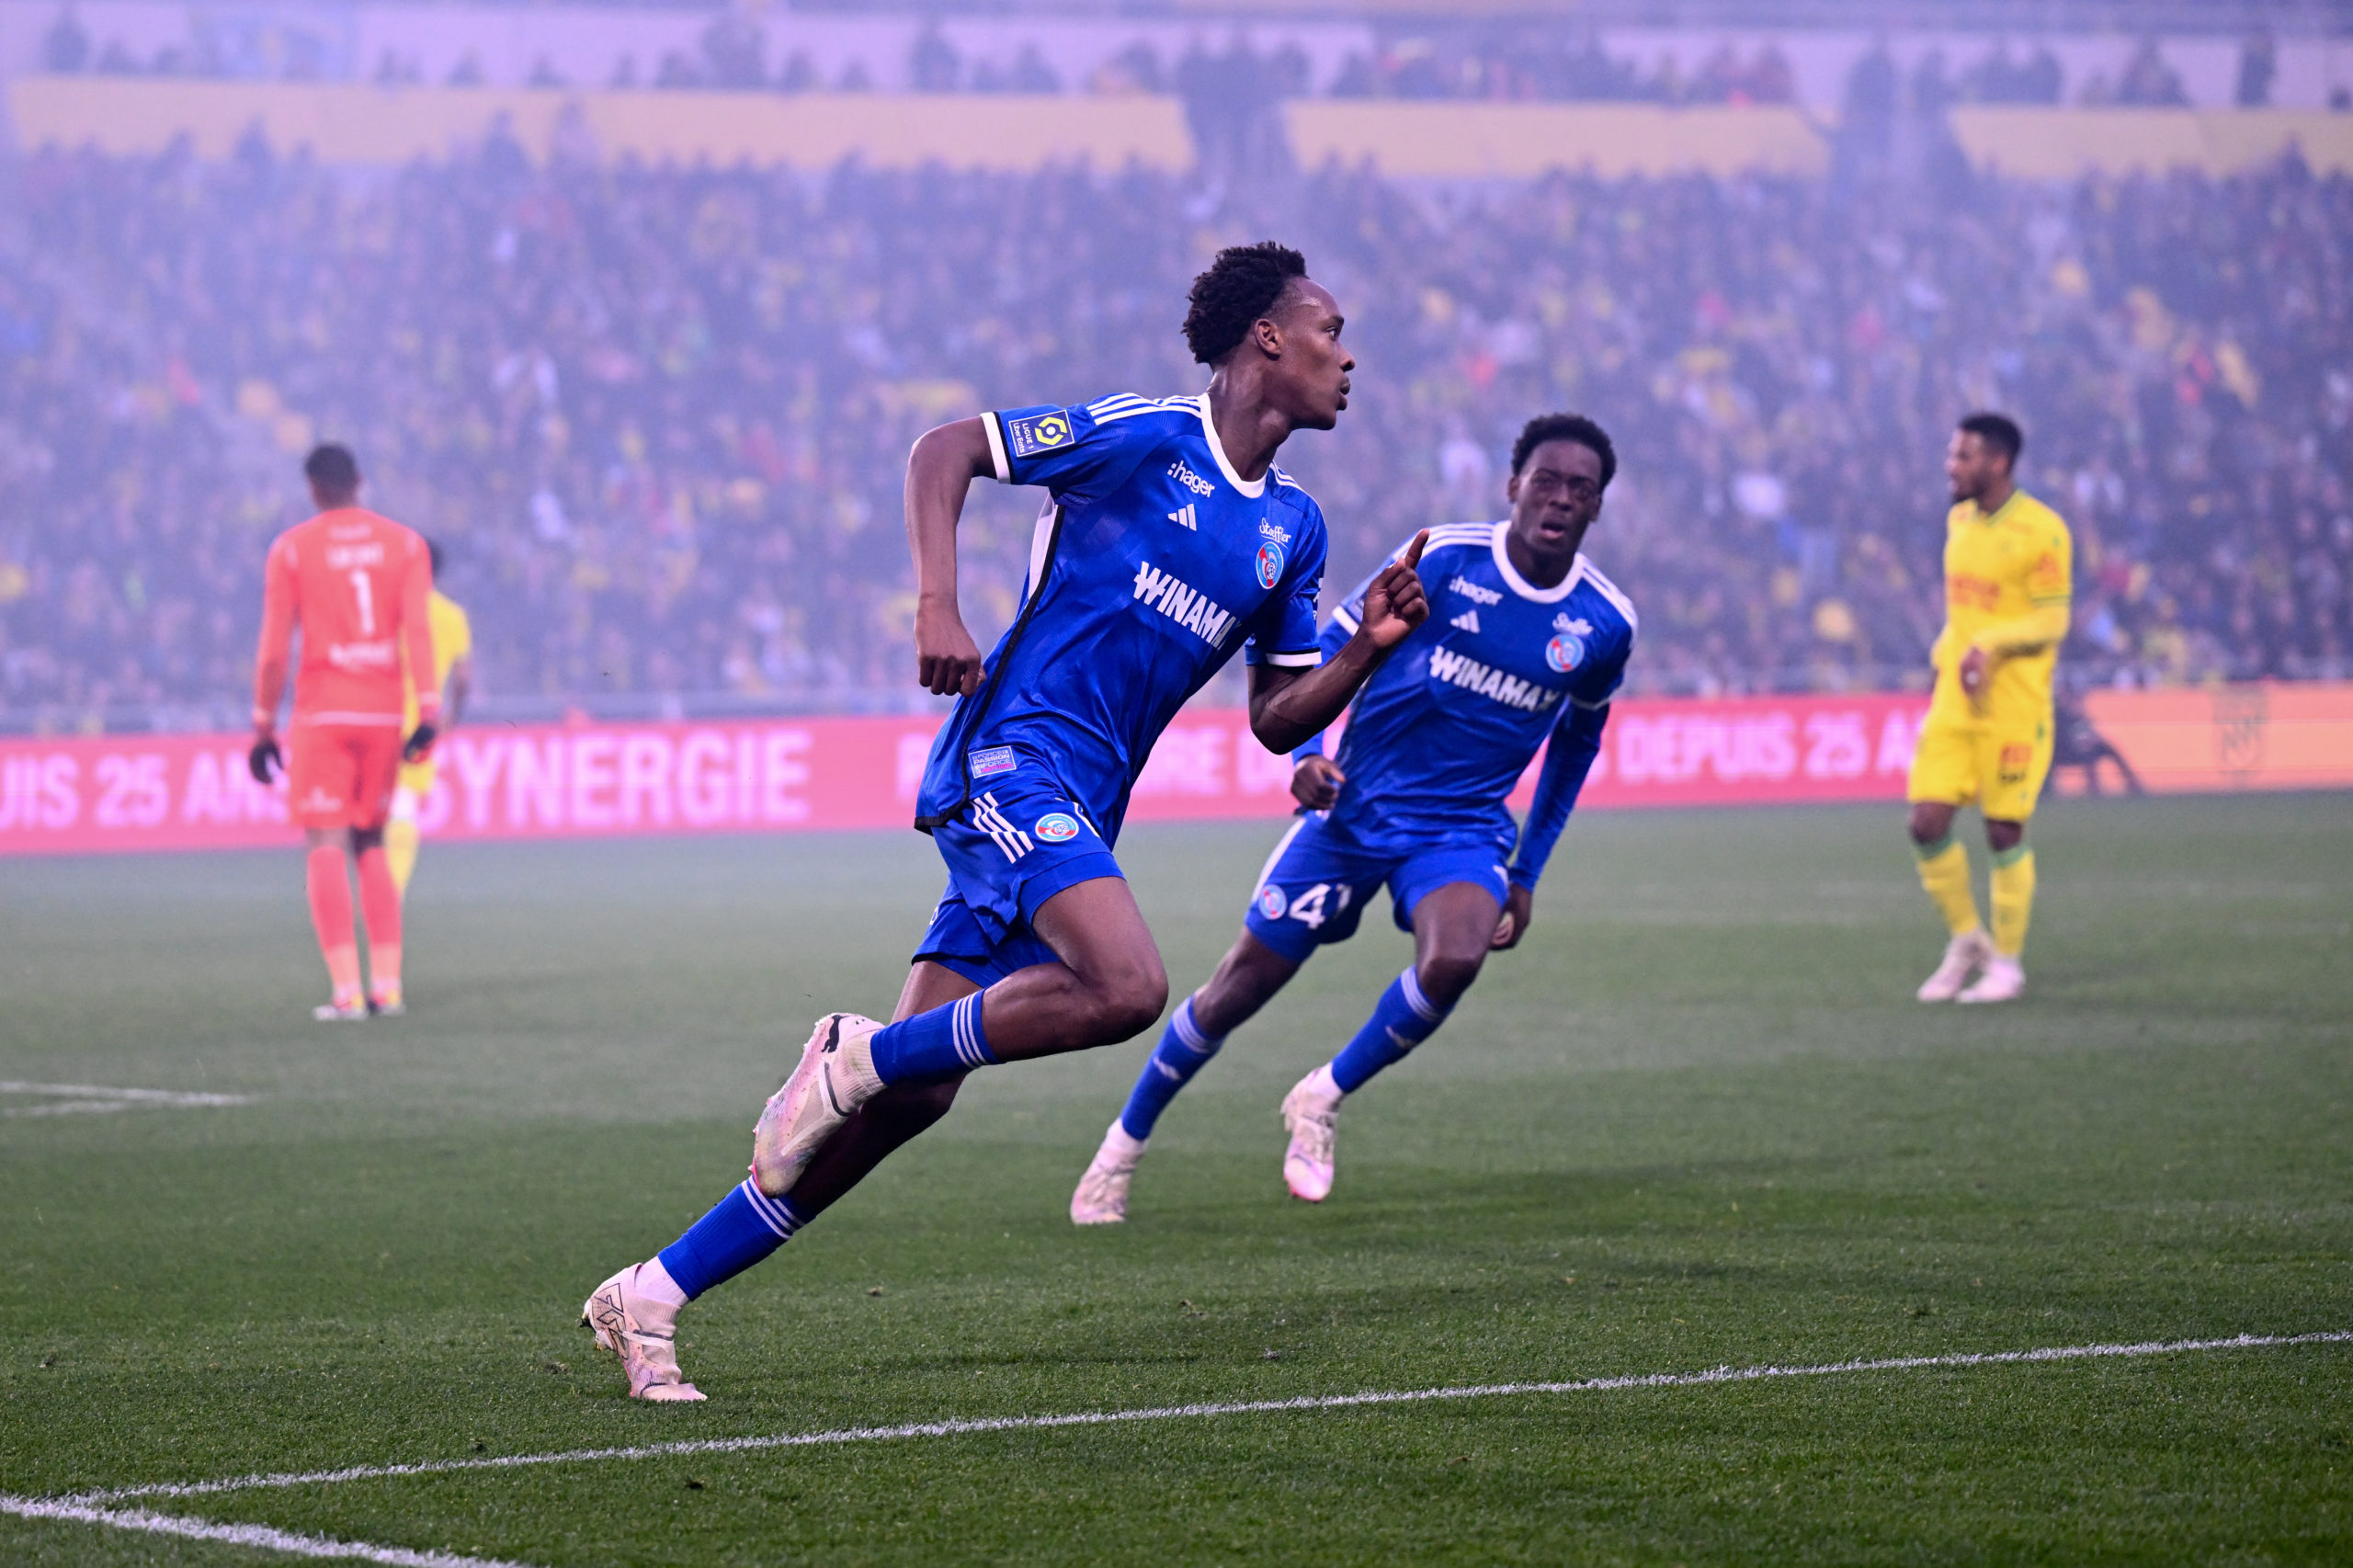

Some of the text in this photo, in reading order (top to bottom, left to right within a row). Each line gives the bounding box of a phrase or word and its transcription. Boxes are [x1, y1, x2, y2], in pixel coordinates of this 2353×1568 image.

[1013, 423, 1026, 454] Uber Eats
[1022, 423, 1032, 445] LIGUE
[349, 569, 376, 636] 1
[1132, 561, 1242, 651] WINAMA
[414, 728, 812, 835] SYNERGIE
[1618, 712, 1798, 784] DEPUIS
[1803, 711, 1870, 779] 25
[96, 753, 169, 827] 25
